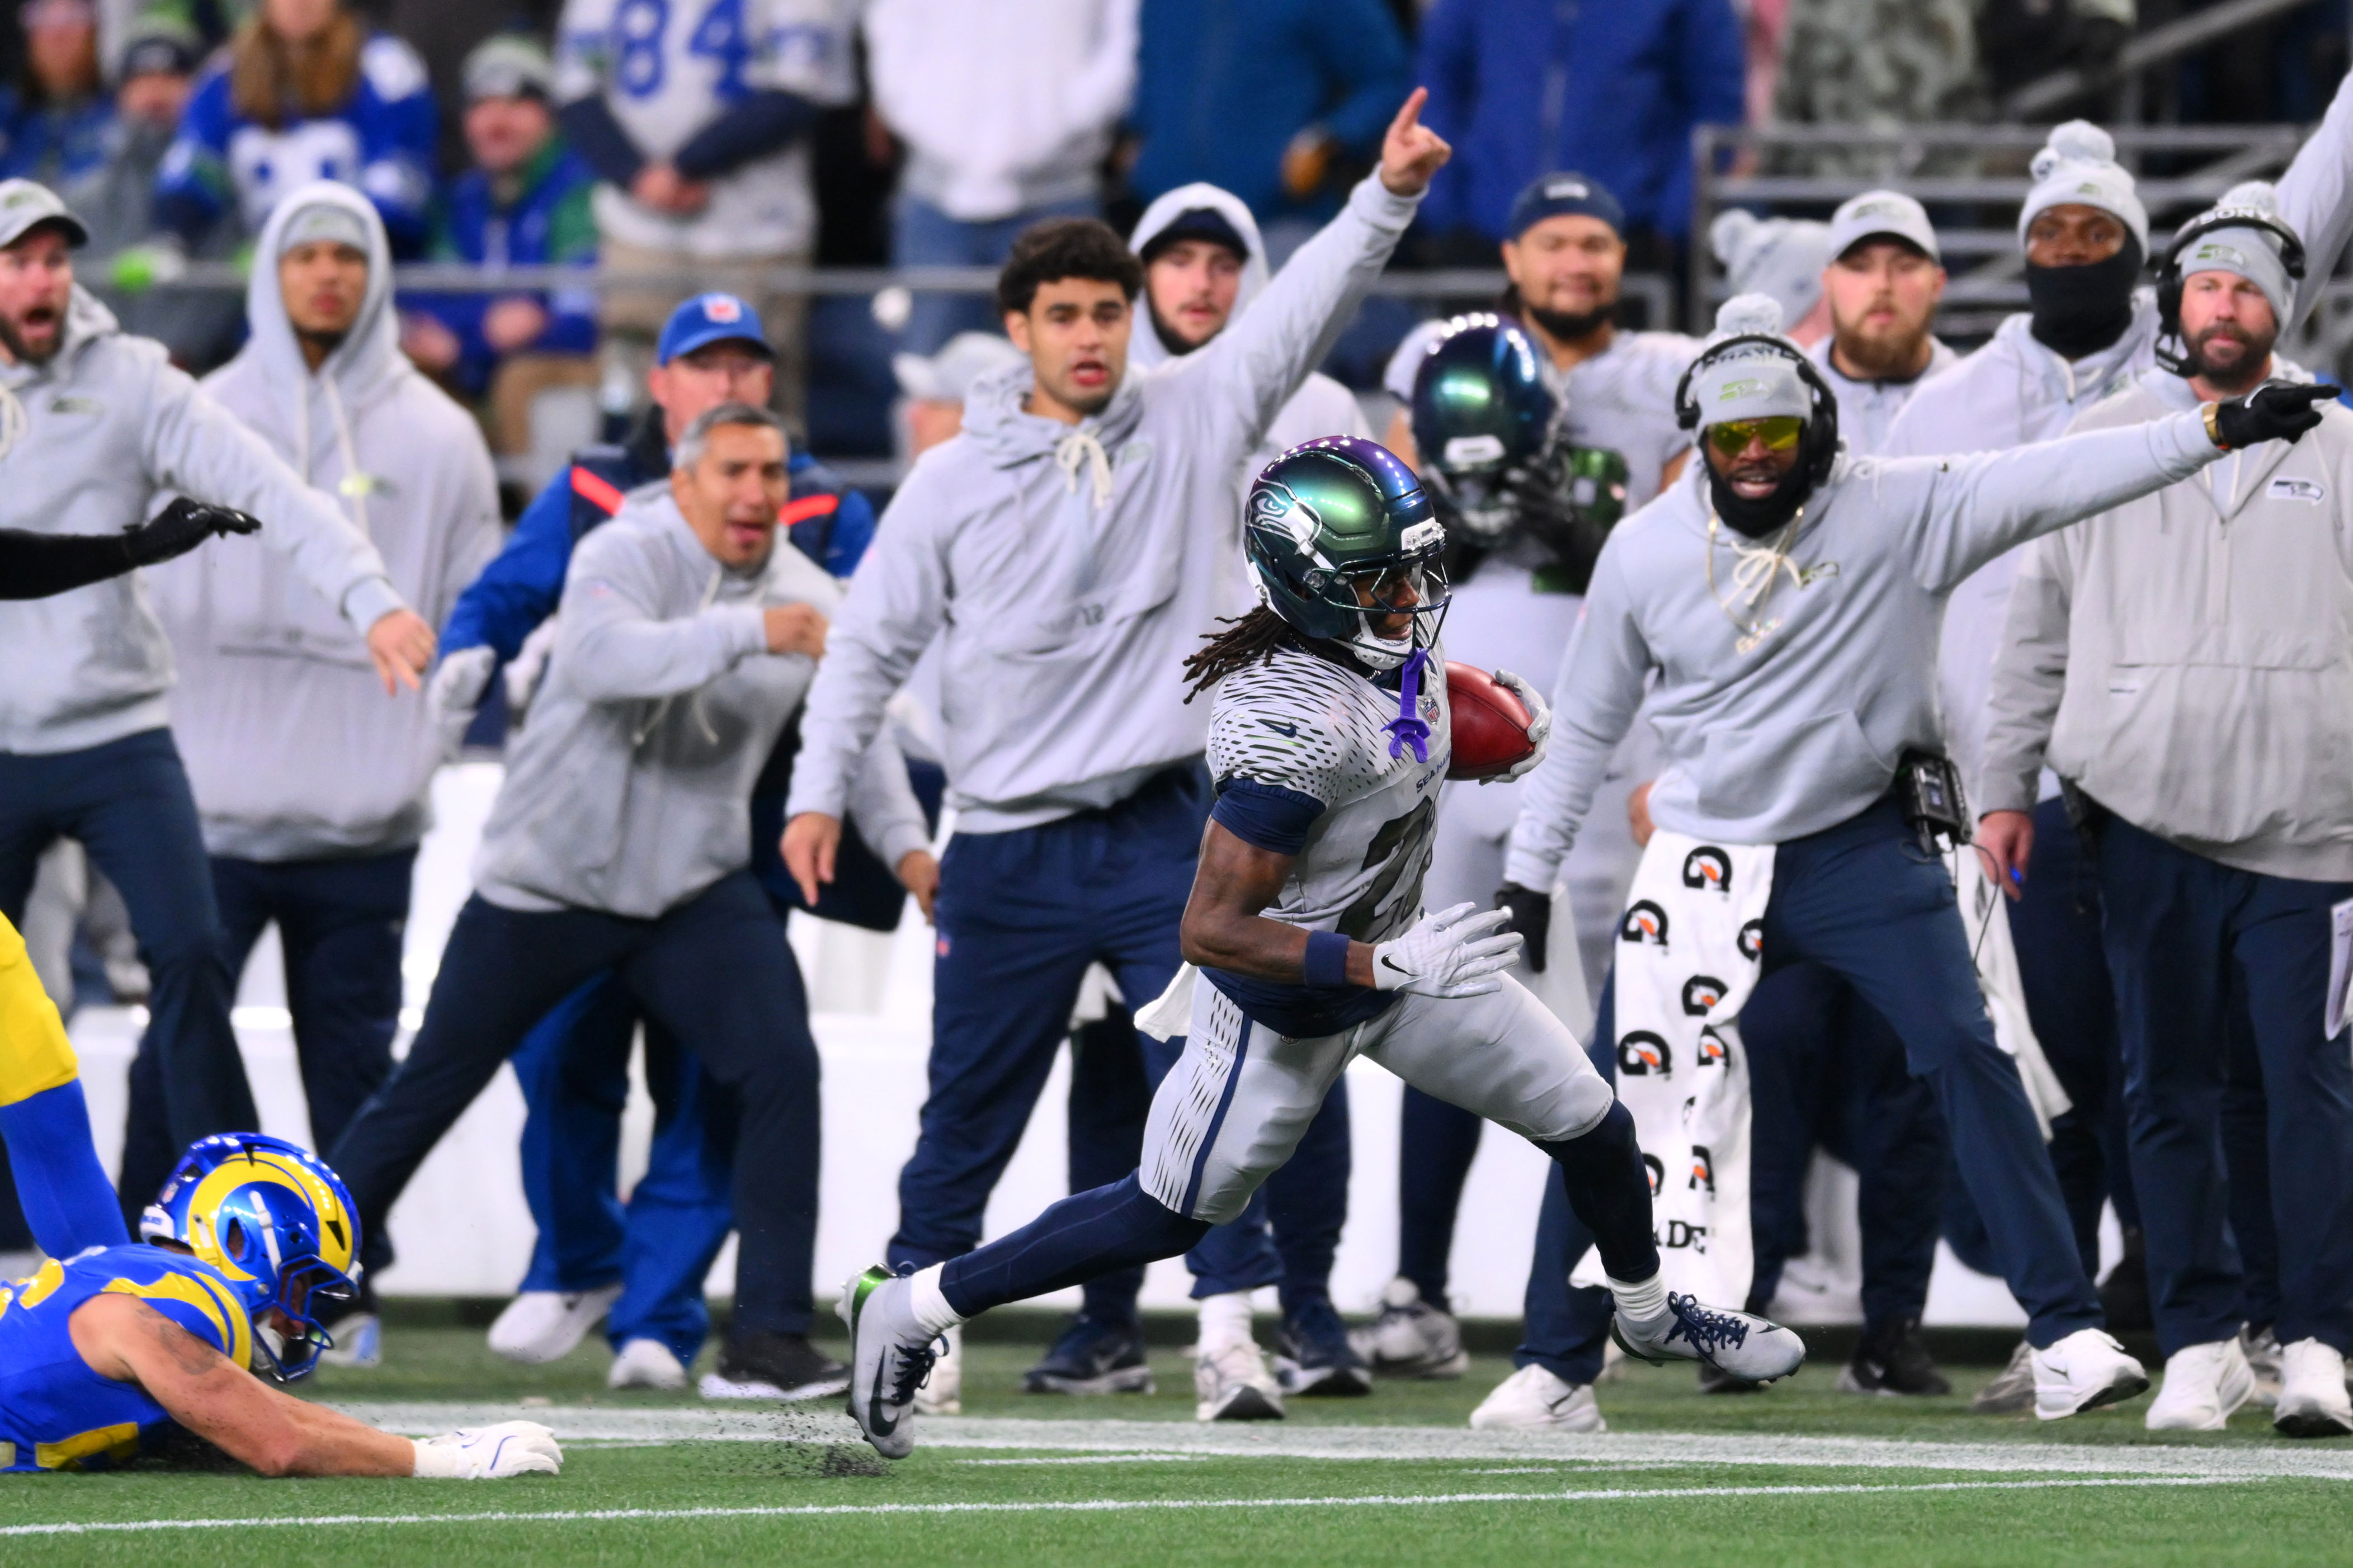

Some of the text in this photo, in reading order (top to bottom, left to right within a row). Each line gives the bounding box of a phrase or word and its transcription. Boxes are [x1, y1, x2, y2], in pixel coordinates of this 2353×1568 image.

[615, 0, 751, 105] 84
[2199, 207, 2272, 225] SONY
[1428, 707, 1440, 720] NFL
[1683, 845, 1732, 893] G
[1621, 899, 1668, 946] G
[1618, 1029, 1672, 1076] G
